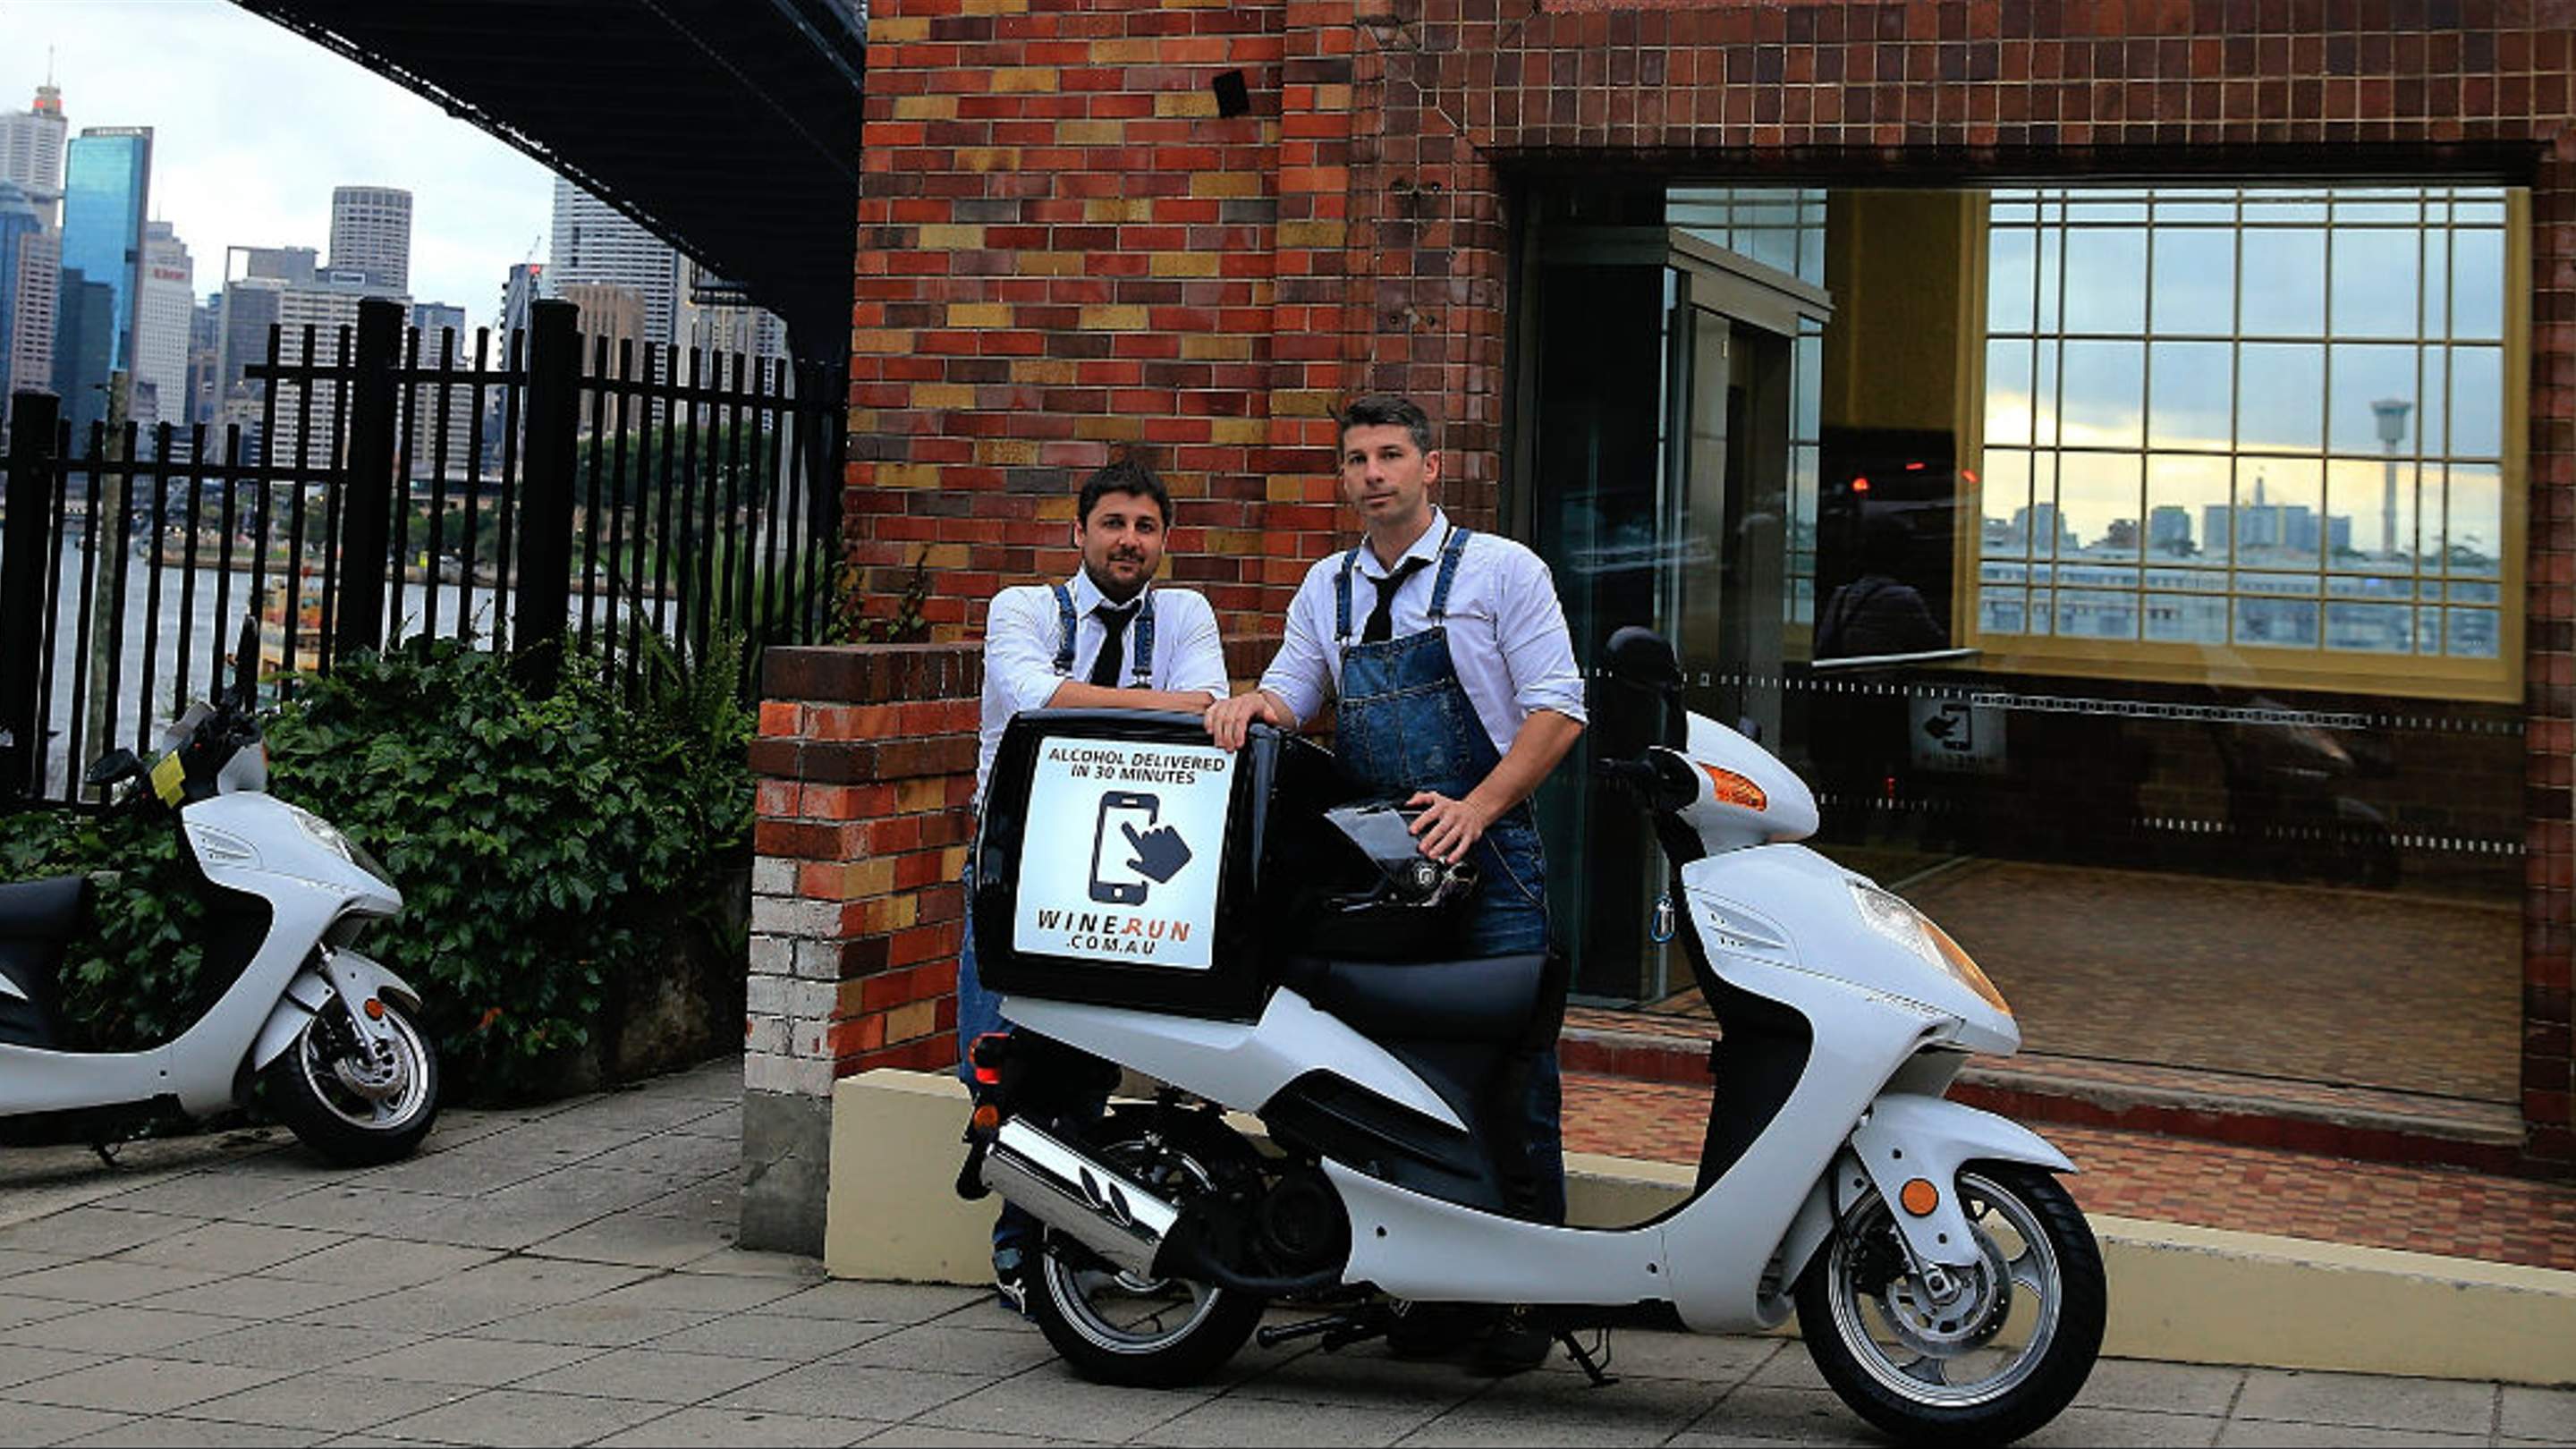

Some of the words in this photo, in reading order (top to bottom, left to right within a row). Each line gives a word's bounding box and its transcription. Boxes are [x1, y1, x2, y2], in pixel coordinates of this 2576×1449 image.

[1048, 748, 1125, 765] ALCOHOL
[1131, 753, 1225, 772] DELIVERED
[1071, 764, 1090, 777] IN
[1094, 766, 1114, 779] 30
[1119, 768, 1196, 784] MINUTES
[1066, 935, 1156, 954] .COM.AU
